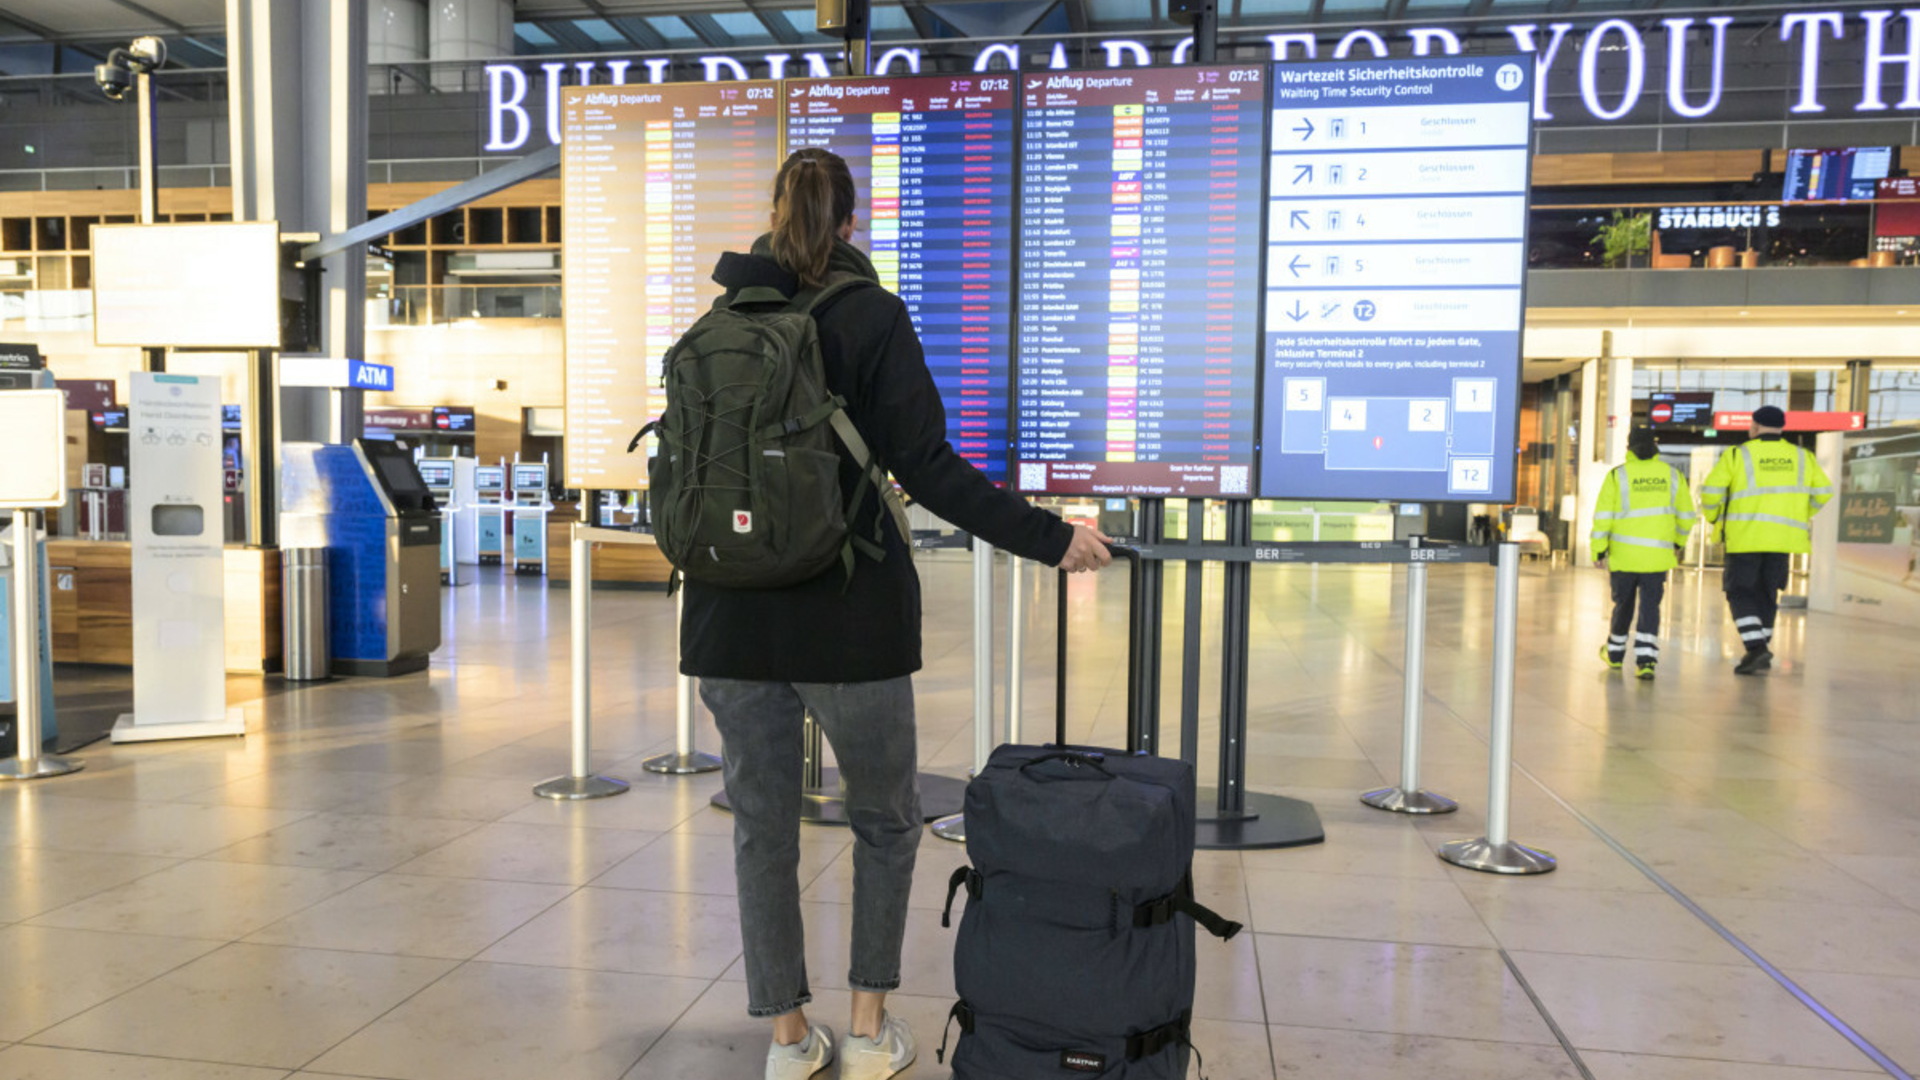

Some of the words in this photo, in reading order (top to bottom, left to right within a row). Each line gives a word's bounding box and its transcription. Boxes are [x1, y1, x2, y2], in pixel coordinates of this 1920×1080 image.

[1281, 68, 1345, 84] Wartezeit
[1348, 64, 1484, 81] Sicherheitskontrolle
[1507, 17, 1734, 120] YOU
[1229, 70, 1259, 82] 07:12
[1500, 71, 1518, 84] T1
[950, 81, 957, 92] 2
[980, 79, 1009, 91] 07:12
[1046, 76, 1083, 91] Abflug
[1086, 77, 1133, 88] Departure
[747, 88, 773, 99] 07:12
[808, 84, 843, 98] Abflug
[846, 85, 890, 96] Departure
[1281, 87, 1319, 100] Waiting
[1322, 86, 1347, 98] Time
[1350, 85, 1392, 99] Security
[1394, 84, 1433, 95] Control
[585, 93, 618, 106] Abflug
[620, 94, 662, 104] Departure
[1420, 117, 1476, 126] Geschlossen
[1360, 122, 1366, 134] 1
[1418, 163, 1475, 173] Geschlossen
[1358, 169, 1367, 181] 2
[1356, 214, 1365, 227] 4
[1659, 212, 1780, 229] STARBUCS
[1355, 260, 1364, 272] 5
[1356, 305, 1374, 317] T2
[1275, 337, 1295, 347] Jede
[1297, 337, 1386, 347] Sicherheitskontrolle
[1388, 337, 1412, 347] führt
[1414, 339, 1425, 347] zu
[1427, 337, 1456, 348] jedem
[1458, 336, 1482, 348] Gate,
[1275, 349, 1315, 358] inklusive
[1317, 349, 1356, 358] Terminal
[1358, 349, 1364, 358] 2
[1275, 361, 1294, 370] Every
[1324, 360, 1344, 368] check
[1374, 362, 1394, 370] every
[1414, 360, 1447, 370] including
[1449, 360, 1477, 368] terminal
[356, 365, 387, 386] ATM
[1300, 389, 1308, 401] 5
[1472, 390, 1477, 401] 1
[1344, 409, 1352, 421] 4
[1422, 409, 1431, 422] 2
[1462, 470, 1479, 481] T2
[1632, 477, 1667, 485] APCOA
[1255, 548, 1280, 560] BER
[1410, 549, 1436, 560] BER
